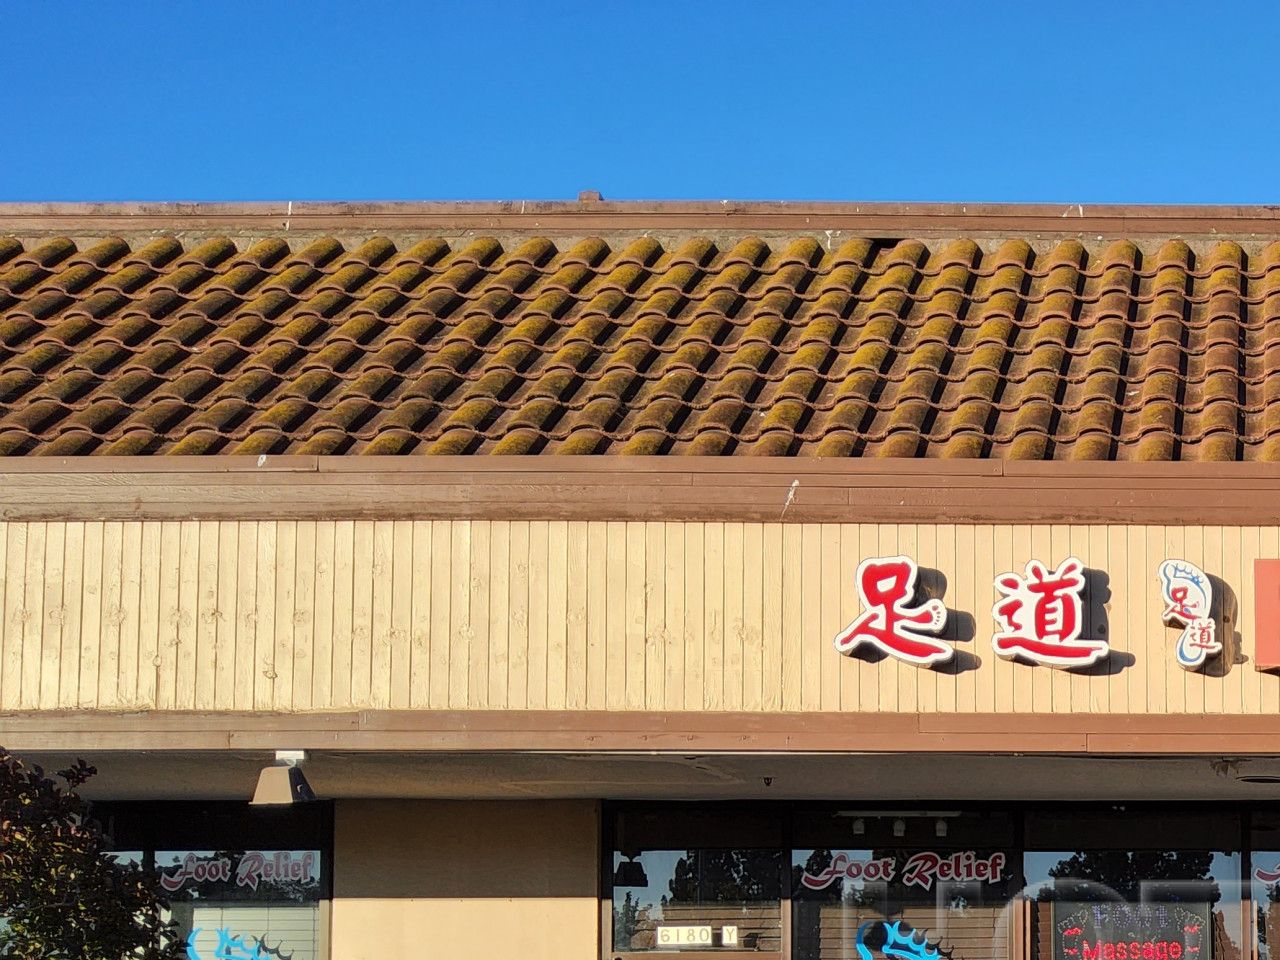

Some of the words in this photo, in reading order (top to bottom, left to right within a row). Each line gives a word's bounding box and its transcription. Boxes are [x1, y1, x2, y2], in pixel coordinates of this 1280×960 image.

[160, 852, 232, 891] Foot
[236, 851, 315, 891] Relief
[801, 852, 896, 890] Foot
[902, 851, 1005, 892] Relief
[660, 928, 710, 942] 6180
[726, 927, 735, 942] Y
